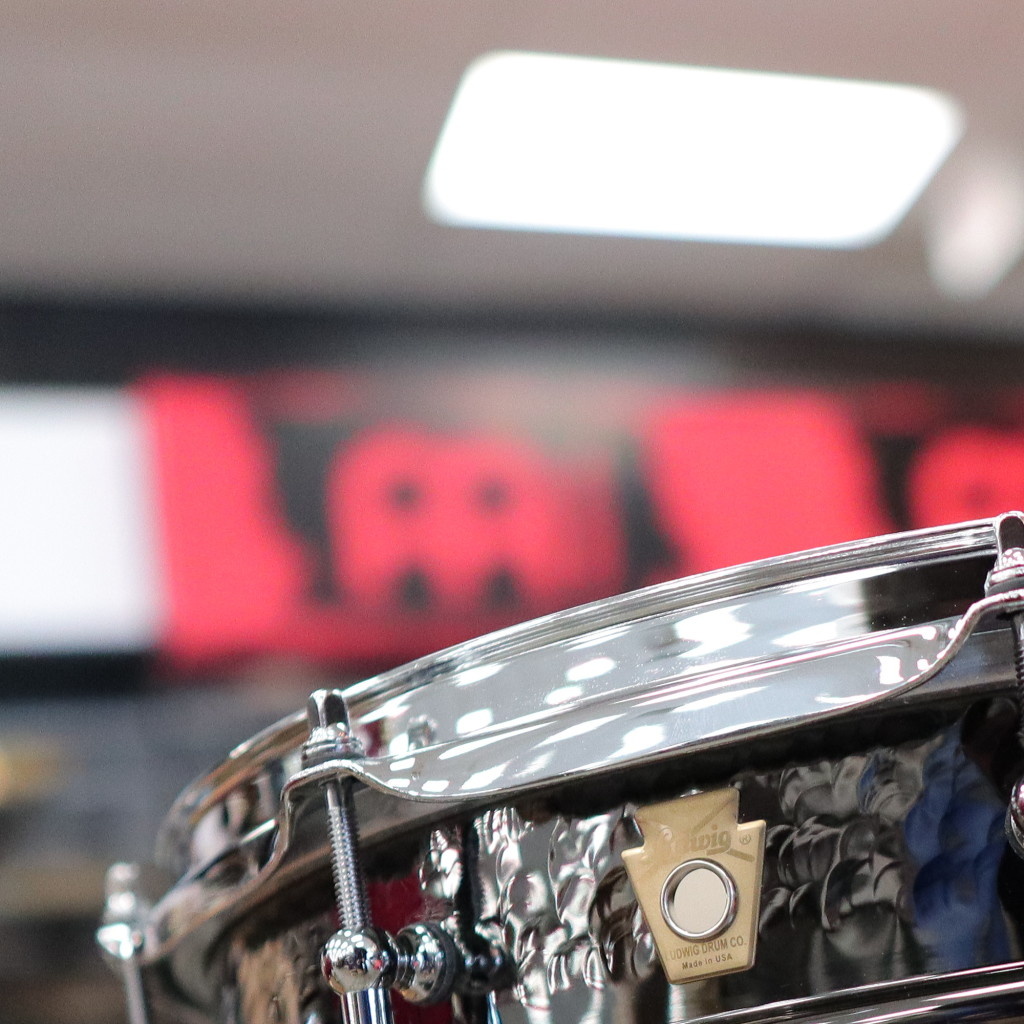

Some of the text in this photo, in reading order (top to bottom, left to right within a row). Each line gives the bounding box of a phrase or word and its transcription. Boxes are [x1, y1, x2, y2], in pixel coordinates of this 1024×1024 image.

[701, 938, 728, 954] DRUM
[730, 935, 747, 948] CO.
[681, 960, 703, 970] Made
[715, 953, 733, 963] USA
